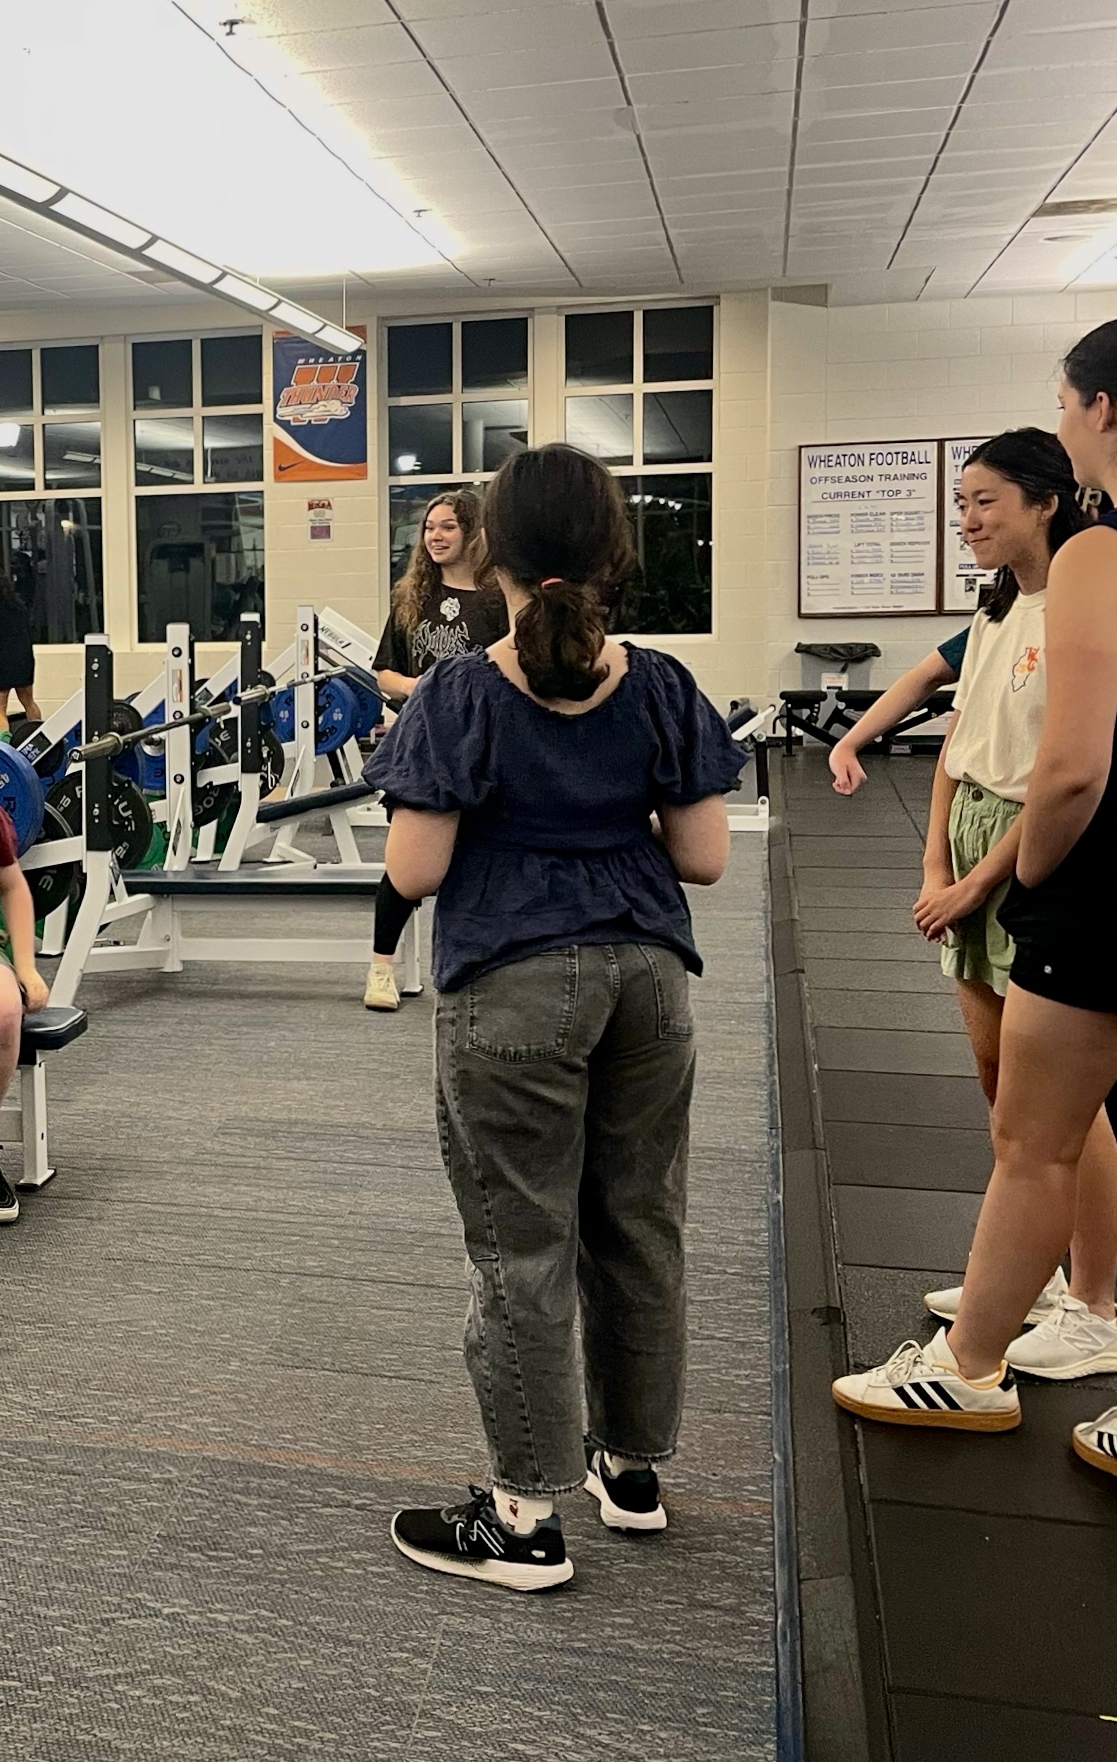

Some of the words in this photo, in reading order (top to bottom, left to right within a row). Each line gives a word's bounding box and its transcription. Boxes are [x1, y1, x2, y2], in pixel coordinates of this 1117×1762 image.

[297, 355, 362, 364] WHEATON
[280, 385, 358, 408] THUNDER
[807, 453, 865, 469] WHEATON
[869, 450, 931, 466] FOOTBALL
[809, 474, 874, 484] OFFSEASON
[878, 472, 928, 481] TRAINING
[821, 490, 872, 500] CURRENT
[876, 489, 902, 498] "TOP
[906, 489, 916, 497] 3"
